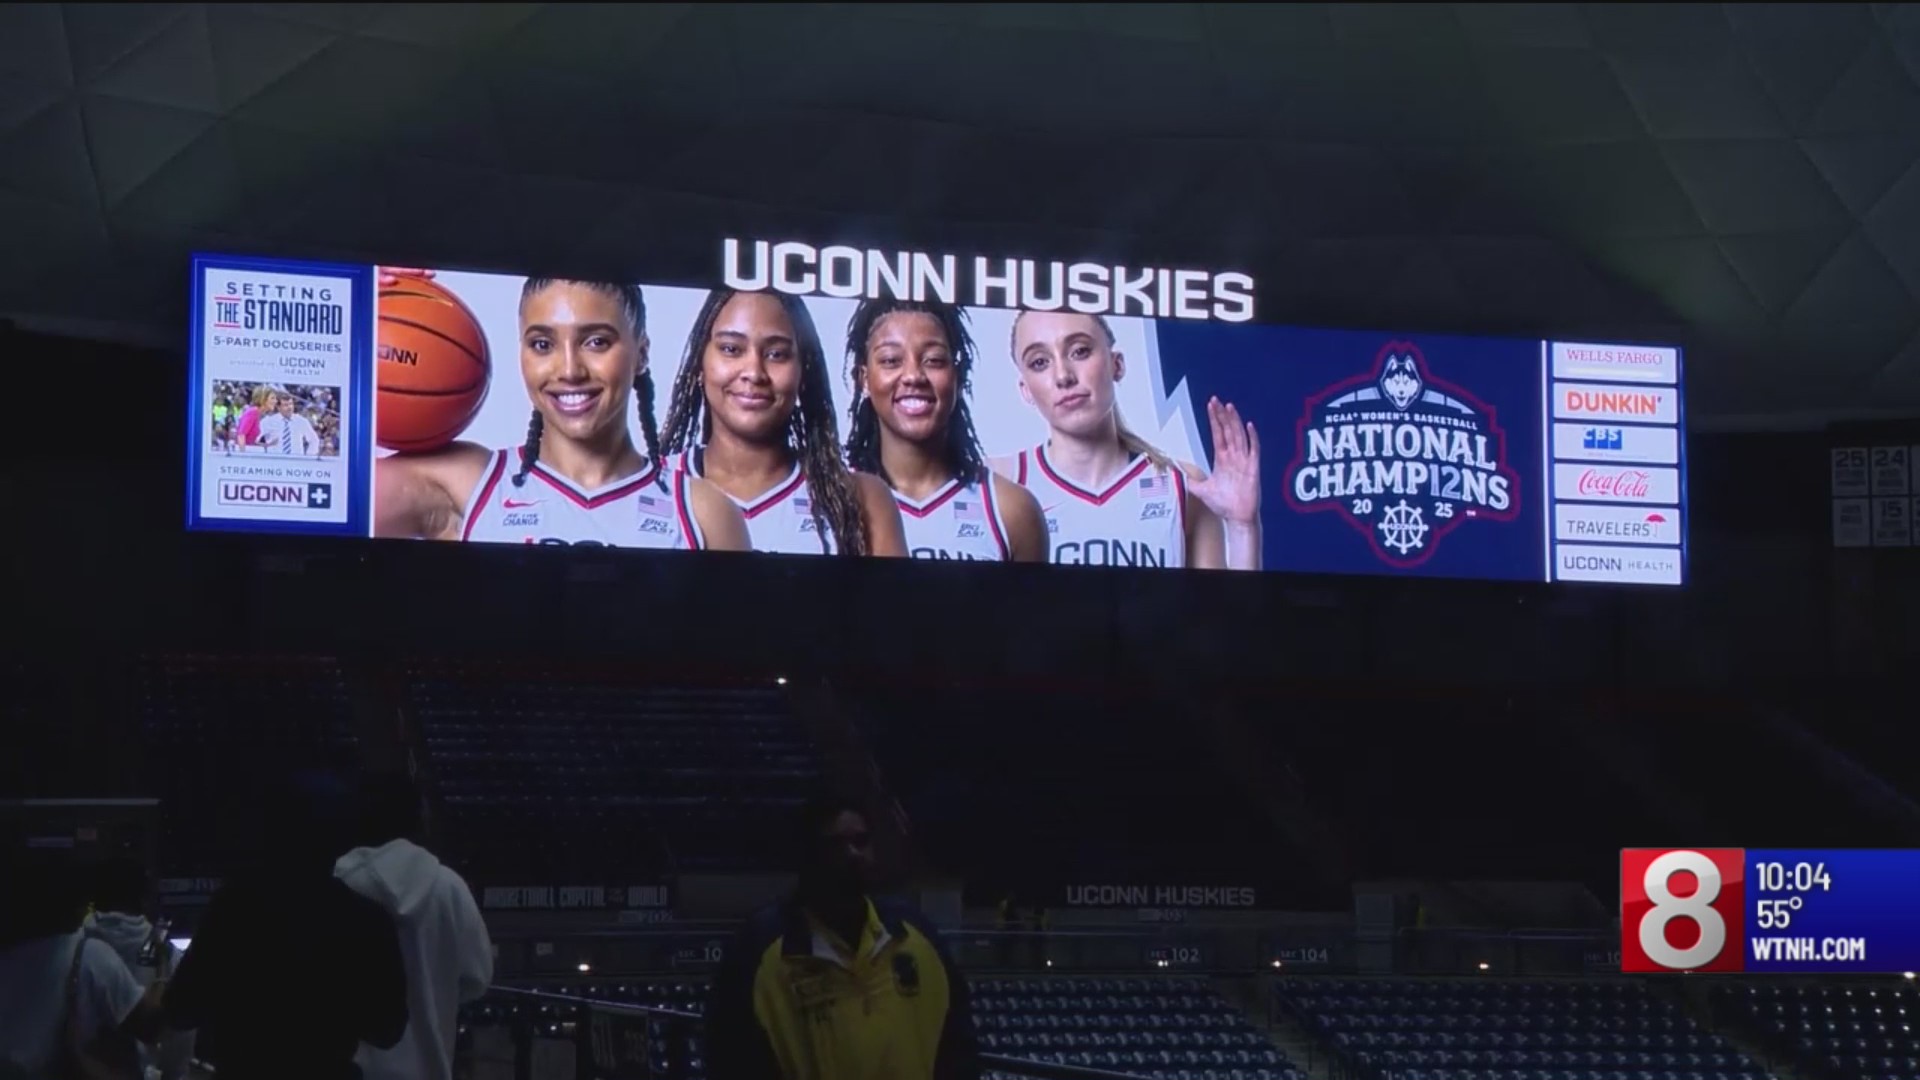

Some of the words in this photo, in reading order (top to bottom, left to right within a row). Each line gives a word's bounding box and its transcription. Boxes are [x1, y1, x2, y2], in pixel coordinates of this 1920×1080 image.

[723, 238, 955, 304] UCONN
[975, 256, 1255, 322] HUSKIES
[226, 281, 332, 301] SETTING
[215, 301, 240, 324] THE
[243, 298, 343, 335] STANDARD
[213, 335, 259, 348] 5-PART
[262, 337, 342, 353] DOCUSERIES
[279, 356, 326, 369] UCONN
[1567, 348, 1613, 363] WELLS
[1617, 351, 1663, 366] FARGO
[1566, 390, 1663, 415] DUNKIN'
[1361, 412, 1410, 422] WOMEN'S
[1413, 413, 1479, 430] BASKETBALL
[1308, 423, 1497, 471] NATIONAL
[220, 466, 283, 476] STREAMING
[286, 469, 312, 478] NOW
[316, 470, 331, 478] ON
[1352, 499, 1373, 515] 20
[1434, 502, 1454, 518] 25
[1566, 519, 1651, 538] TRAVELERS
[1564, 555, 1622, 571] UCONN
[1628, 560, 1673, 570] HEALTH
[1066, 885, 1148, 904] UCONN
[1155, 886, 1255, 906] HUSKIES
[1171, 948, 1199, 962] 102
[1299, 949, 1328, 962] 104
